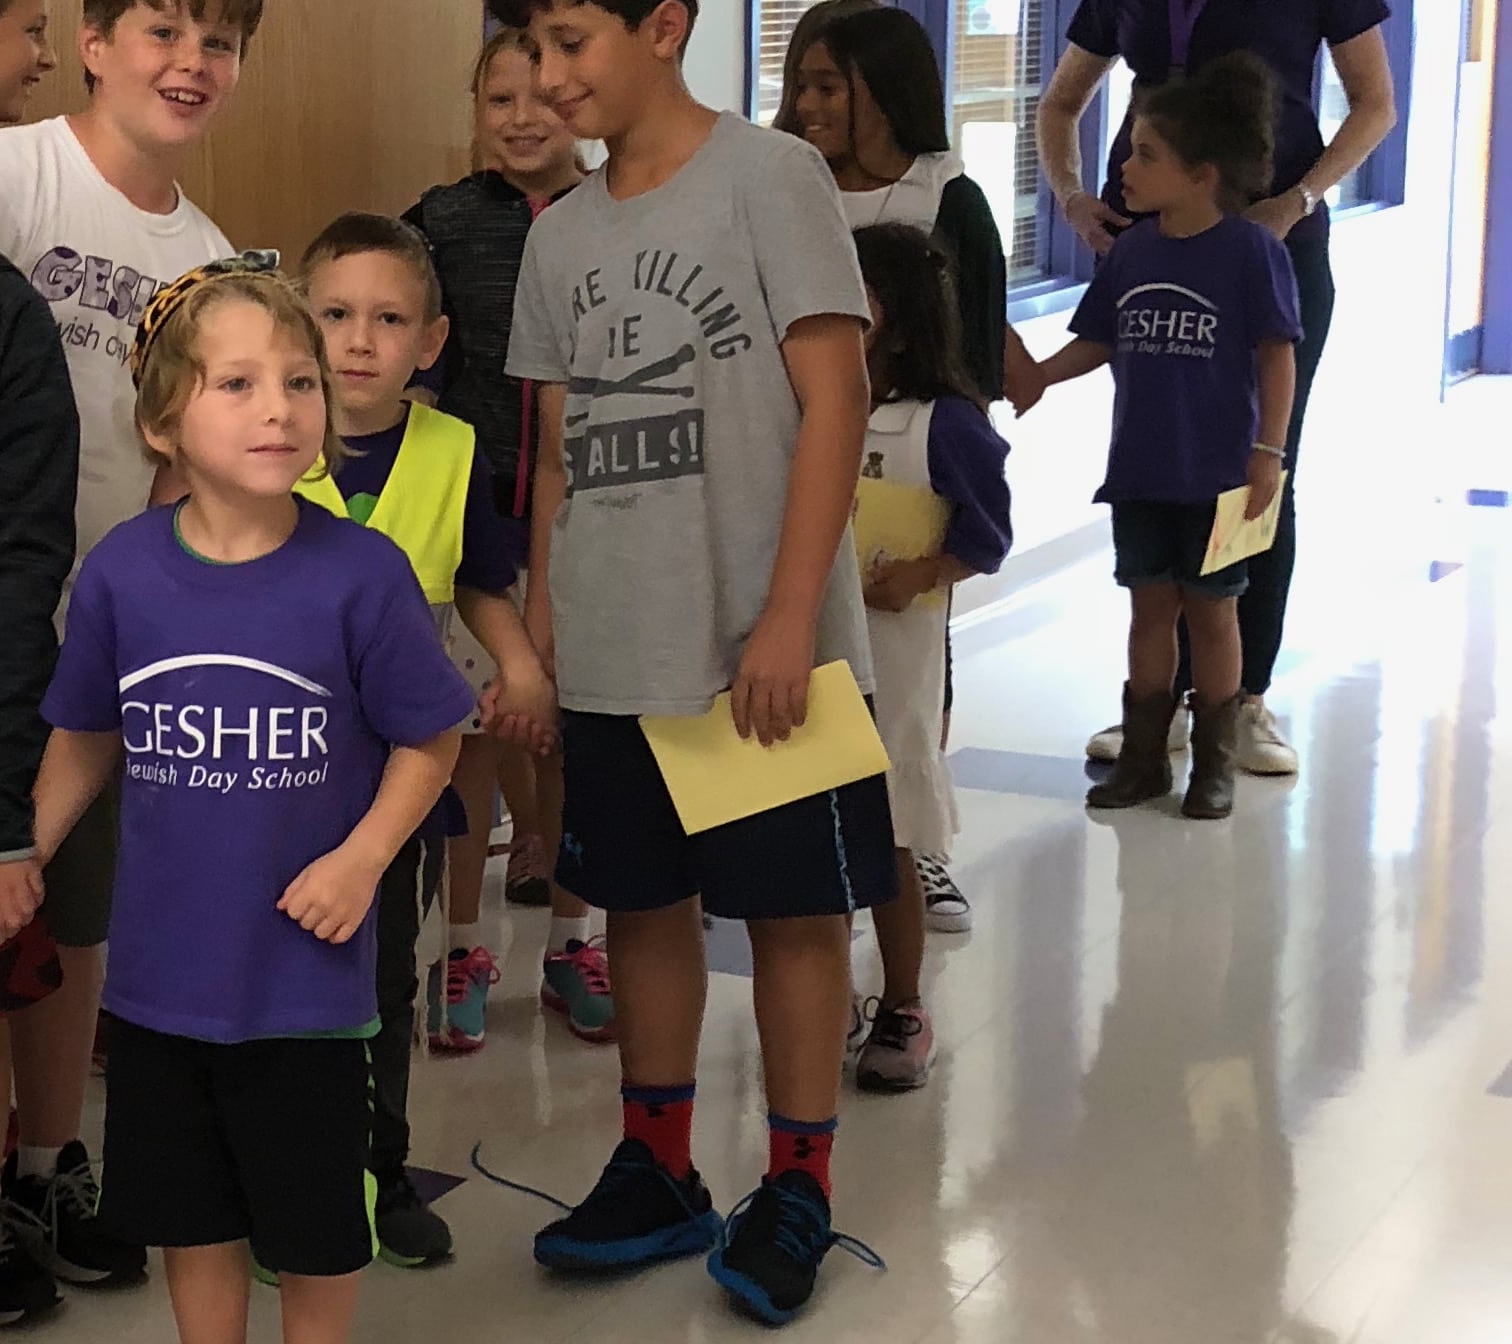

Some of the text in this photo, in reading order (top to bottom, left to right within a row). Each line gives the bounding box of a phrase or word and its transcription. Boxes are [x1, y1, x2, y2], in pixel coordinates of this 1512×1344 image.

[121, 701, 329, 760] GESHER
[188, 765, 238, 794] Day
[247, 761, 329, 790] School
